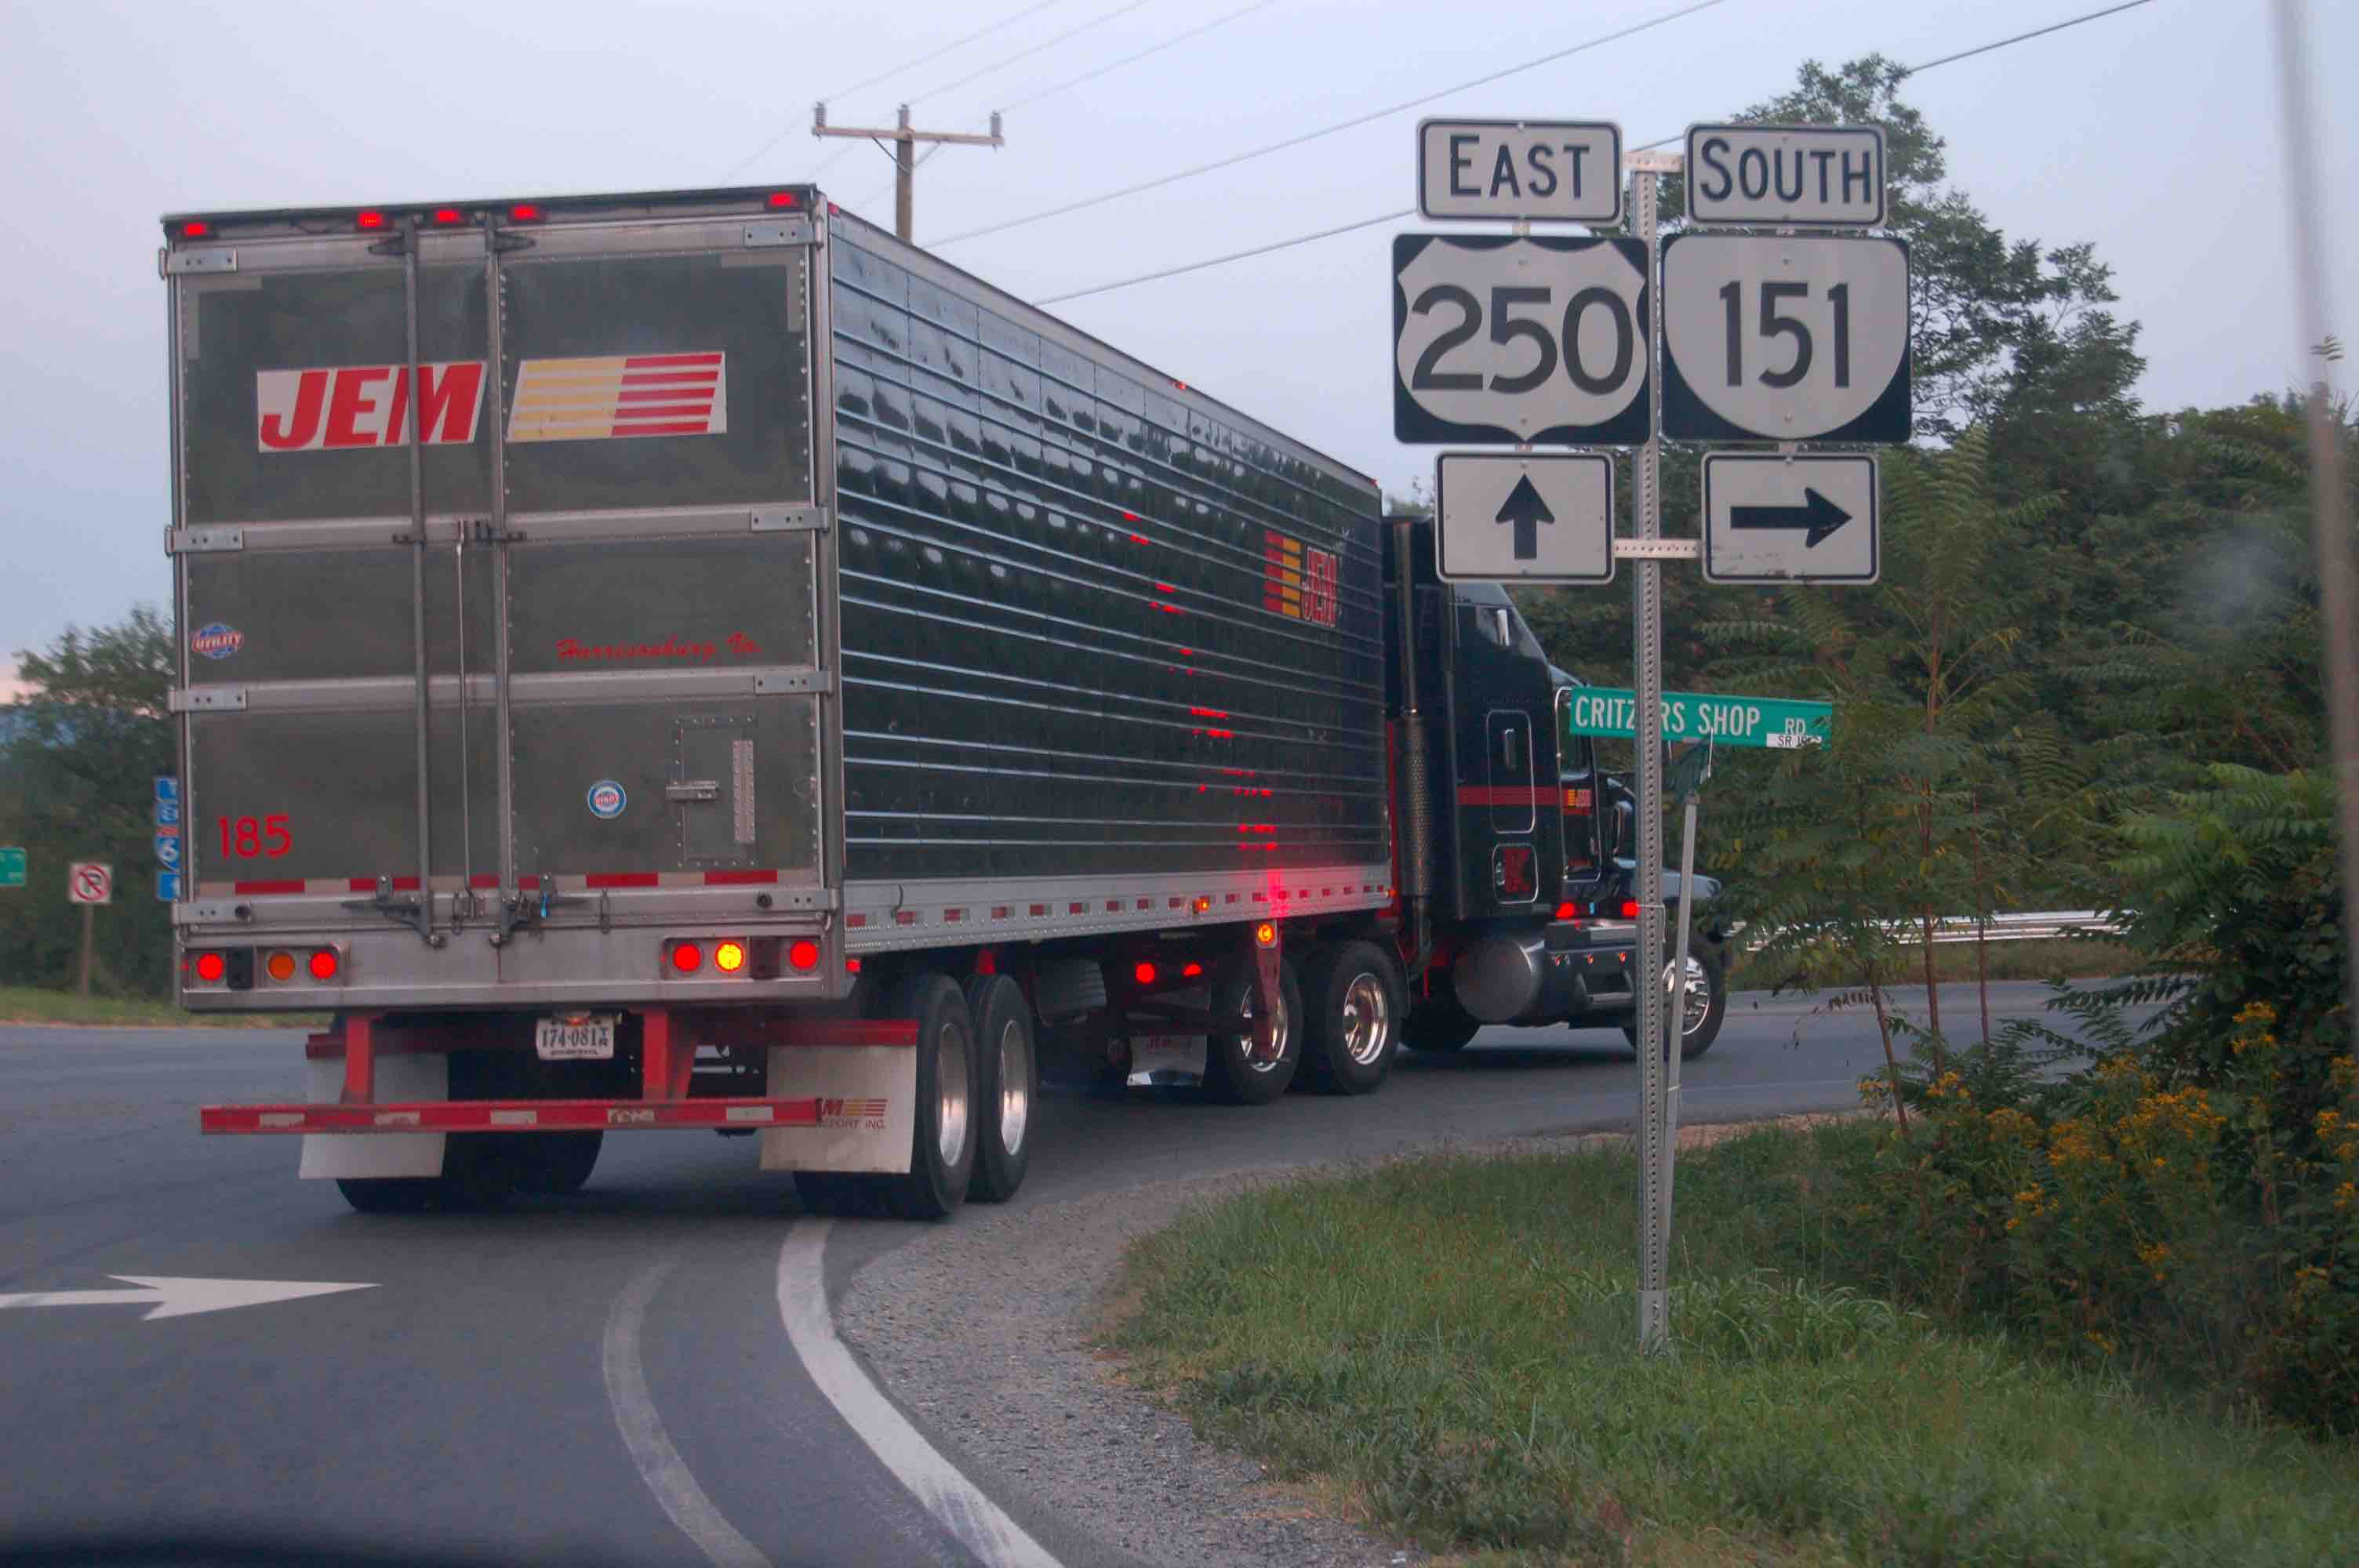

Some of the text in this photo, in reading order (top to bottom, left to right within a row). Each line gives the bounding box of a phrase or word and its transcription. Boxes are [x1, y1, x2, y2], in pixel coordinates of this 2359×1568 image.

[1449, 134, 1590, 199] EAST
[1699, 137, 1871, 204] SOUTH
[1412, 285, 1634, 395] 250
[1719, 281, 1850, 388] 151
[260, 362, 483, 449] JEM
[1575, 696, 1761, 736] CRITZRS SHOP
[1785, 717, 1806, 735] RD
[219, 815, 293, 860] 185
